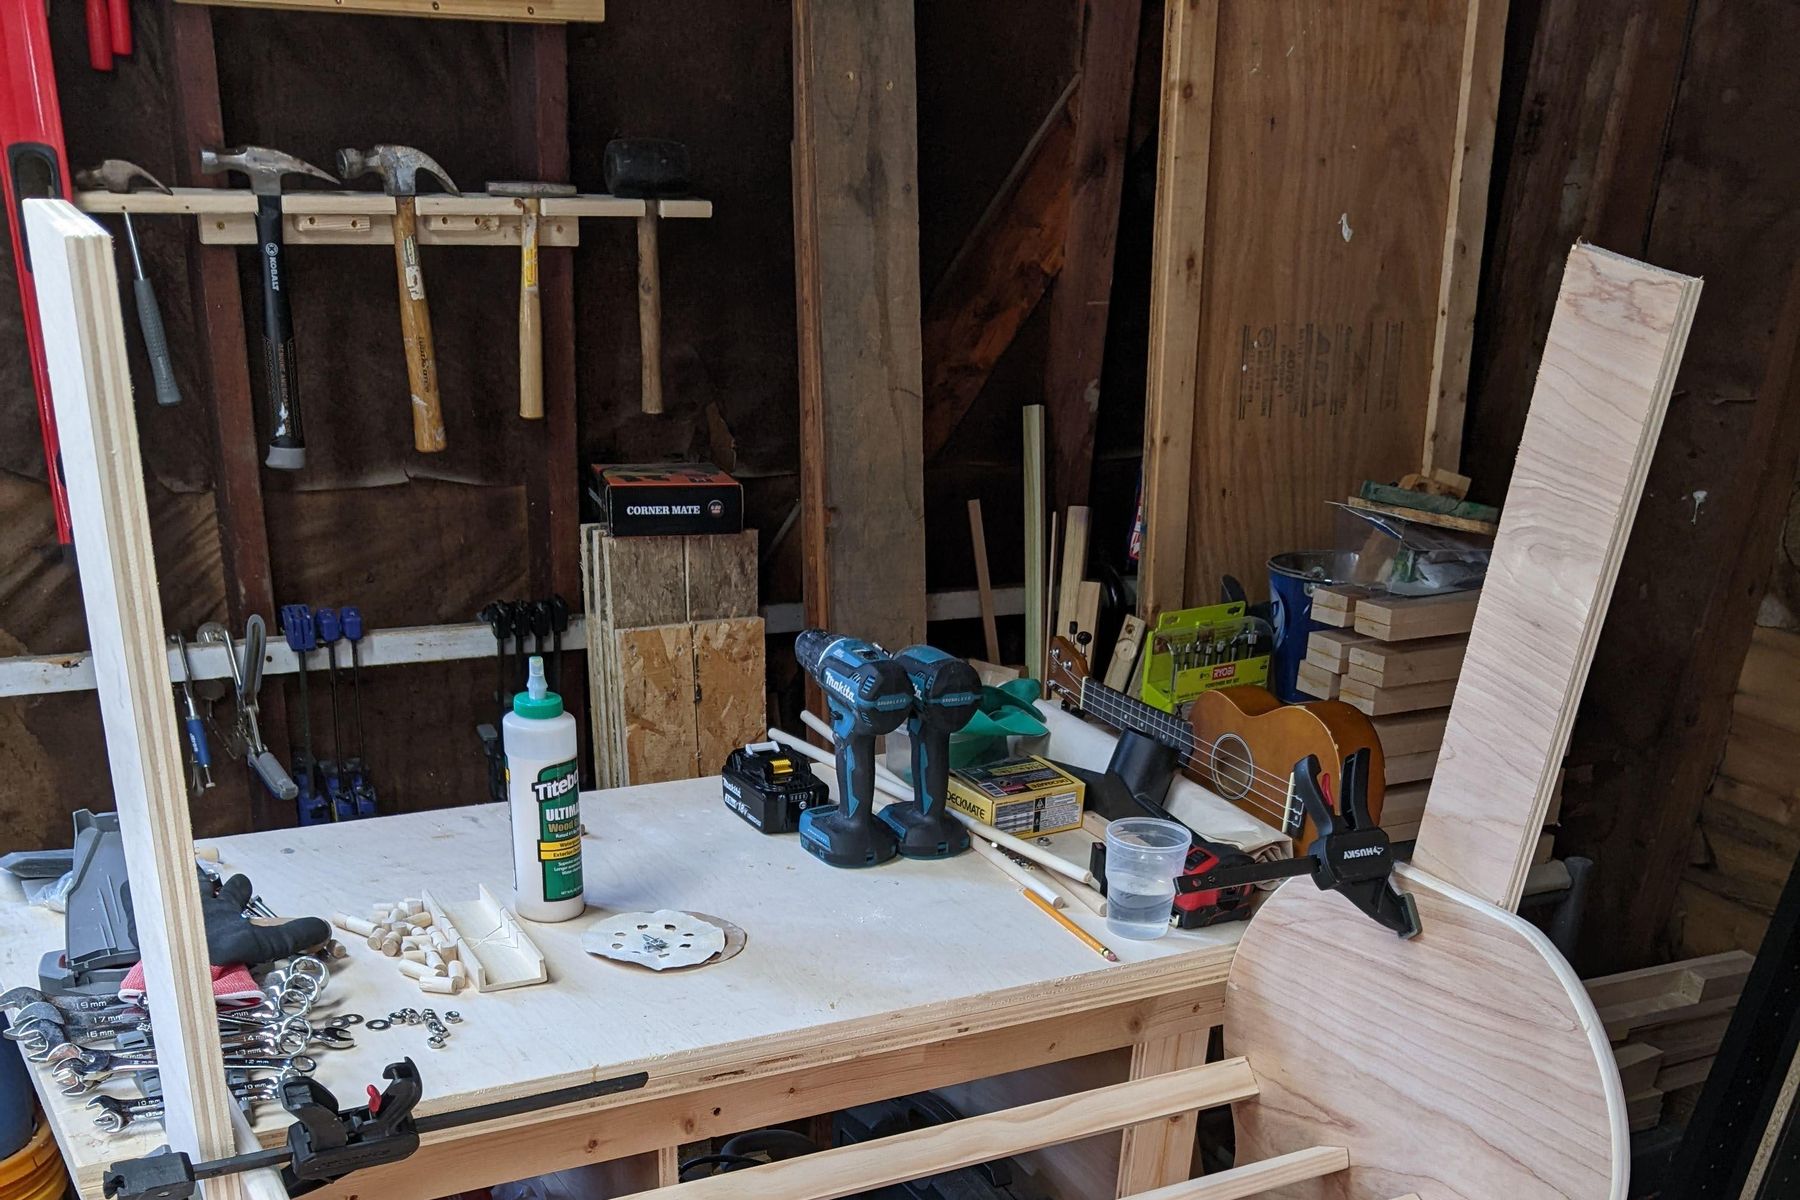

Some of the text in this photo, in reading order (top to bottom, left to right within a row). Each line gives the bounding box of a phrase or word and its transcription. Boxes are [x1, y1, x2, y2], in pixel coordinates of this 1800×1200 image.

[269, 257, 279, 291] KOBALT
[626, 505, 670, 515] CORNER
[672, 505, 700, 515] MATE
[1213, 666, 1235, 679] RYOBI
[825, 671, 855, 703] Makita
[946, 791, 985, 820] DECKMATE
[1343, 847, 1374, 860] HUSKY
